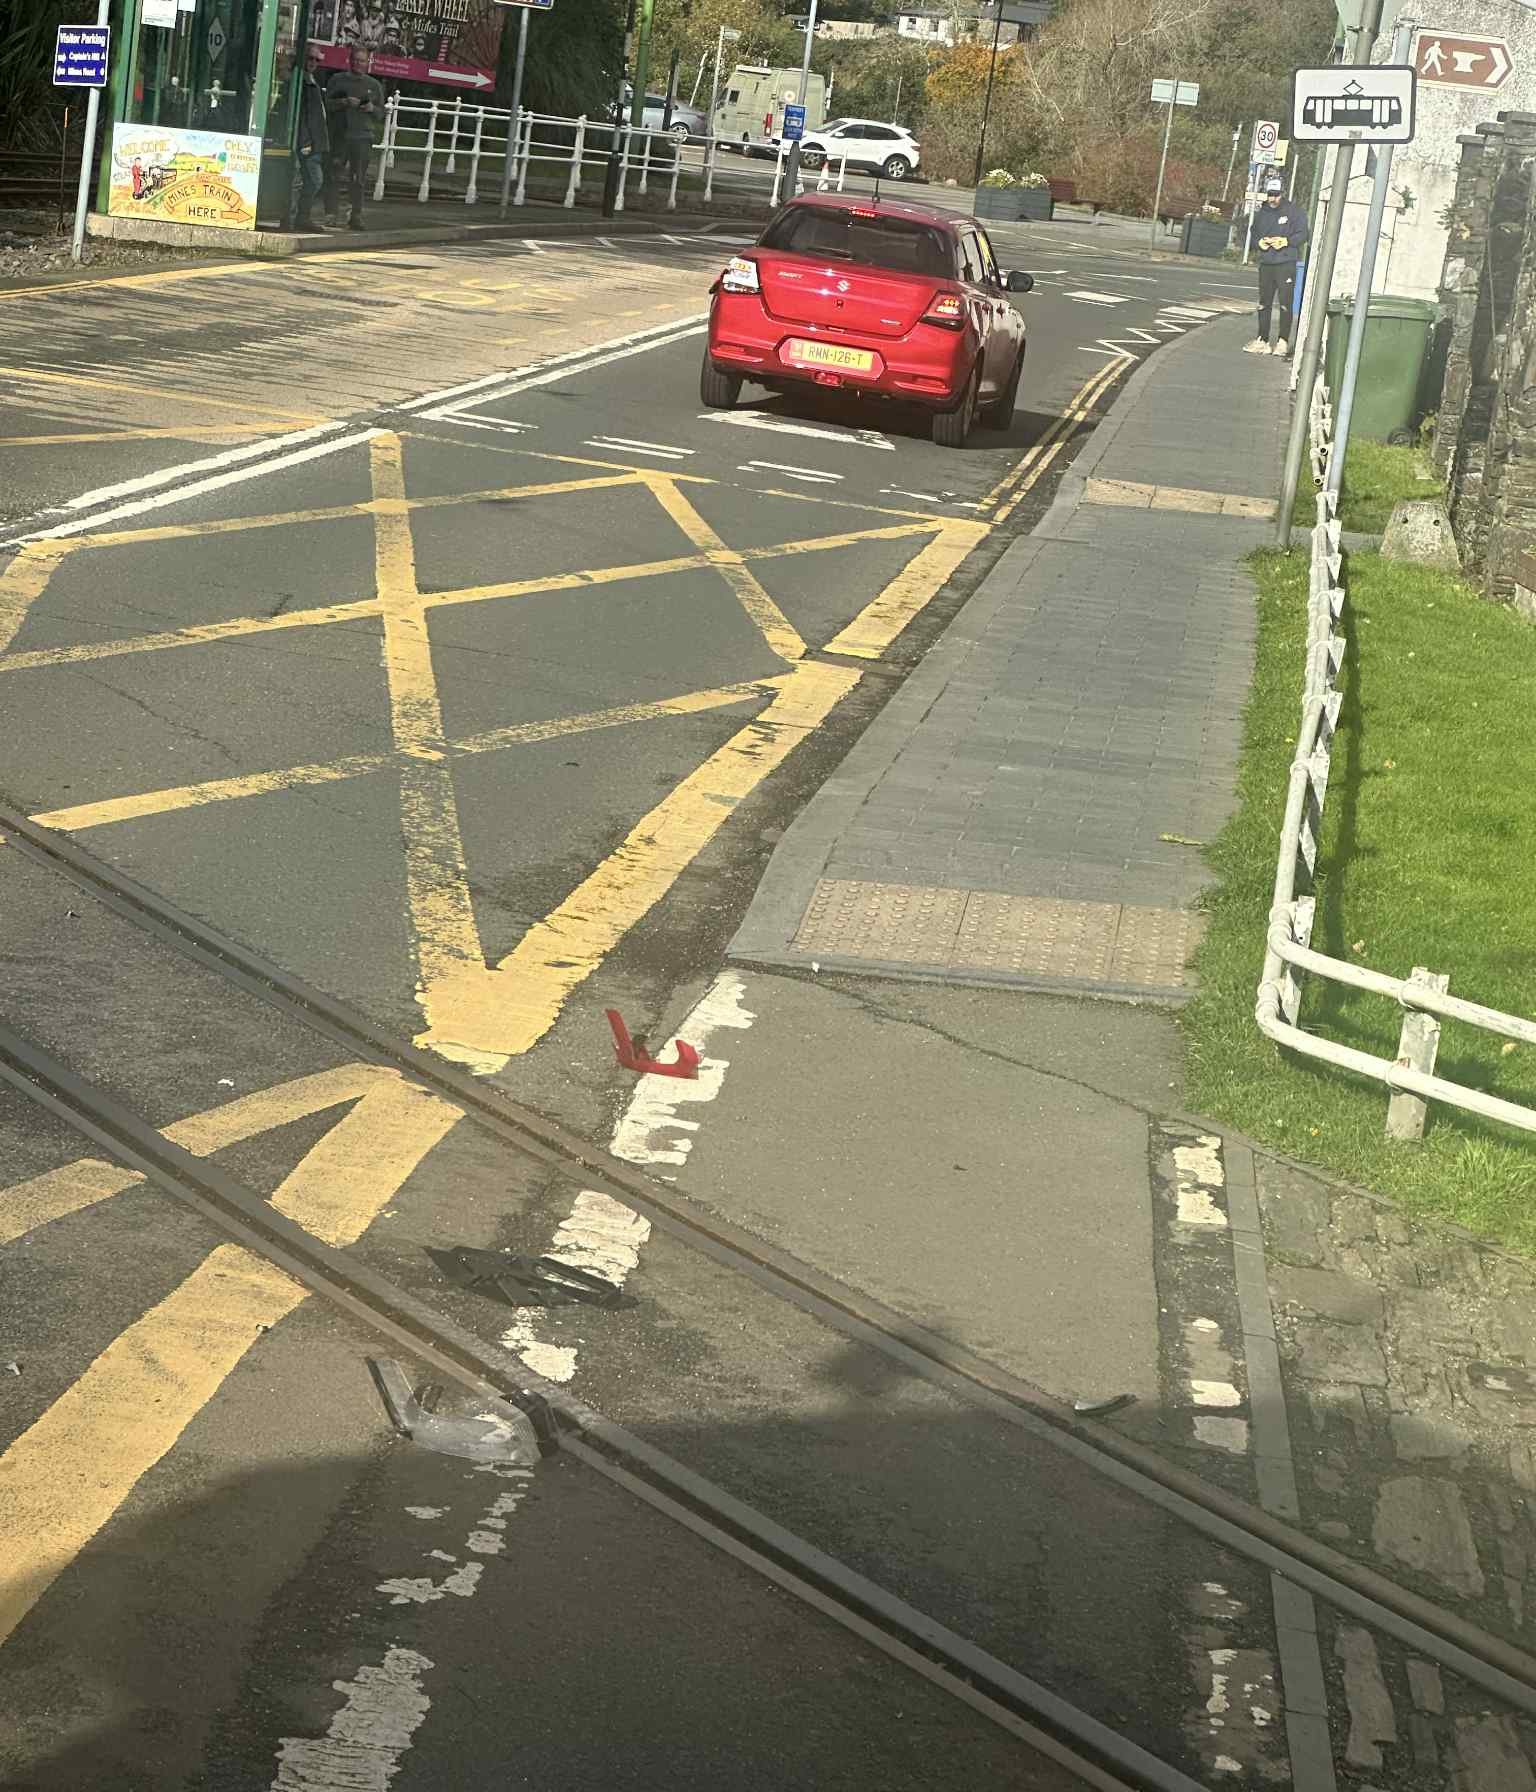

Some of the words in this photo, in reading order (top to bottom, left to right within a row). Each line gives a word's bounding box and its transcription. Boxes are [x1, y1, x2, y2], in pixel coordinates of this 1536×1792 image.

[434, 0, 469, 22] WHEEL
[413, 17, 437, 33] Mines
[438, 22, 460, 37] Trail
[60, 32, 80, 44] Visitor
[81, 33, 106, 47] Parking
[1260, 131, 1274, 141] 30
[166, 184, 197, 205] MINES
[202, 184, 232, 202] TRAIN
[187, 205, 217, 219] HERE
